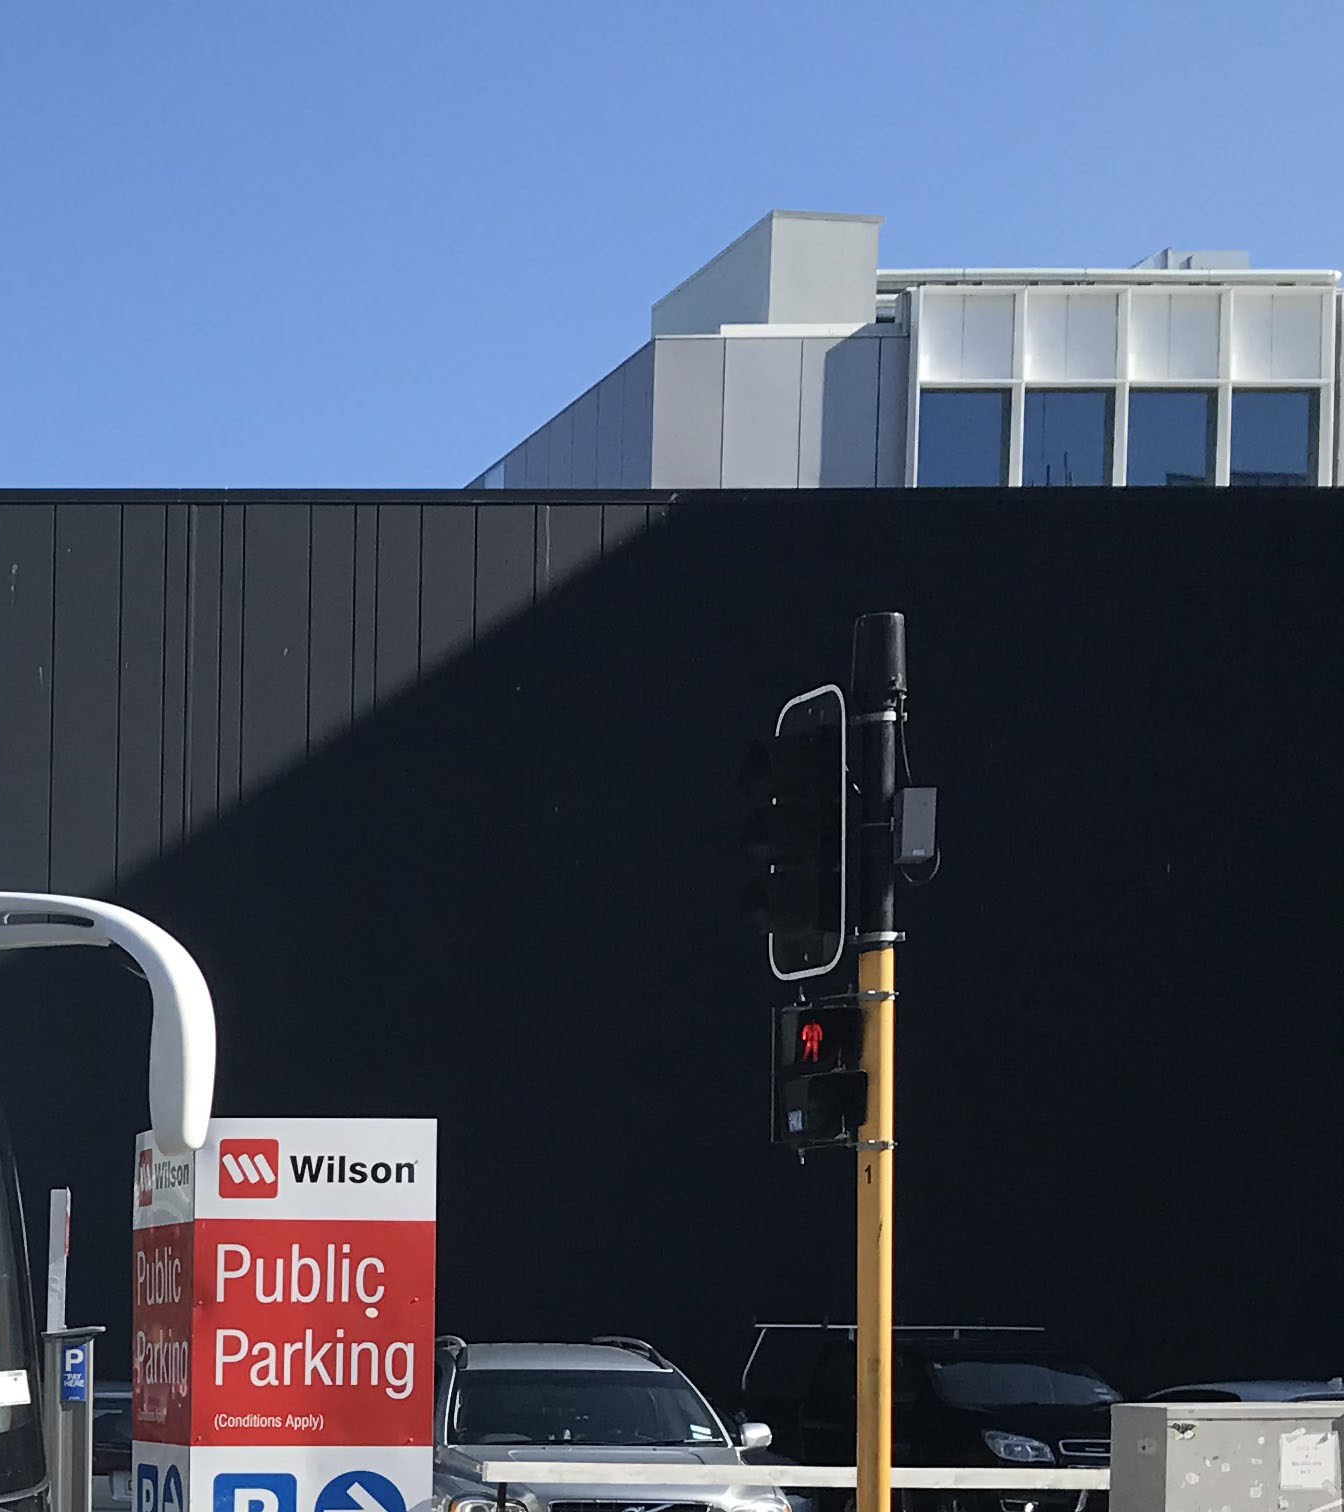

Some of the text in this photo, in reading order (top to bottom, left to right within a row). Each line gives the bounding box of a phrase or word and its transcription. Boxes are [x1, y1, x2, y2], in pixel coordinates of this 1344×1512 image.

[154, 1159, 190, 1190] Wilson
[289, 1155, 415, 1184] Wilson
[864, 1164, 872, 1184] 1
[137, 1247, 181, 1306] Public
[216, 1243, 385, 1304] Public
[66, 1348, 84, 1372] P
[137, 1329, 188, 1397] Parking
[215, 1328, 415, 1400] Parking
[214, 1413, 324, 1430] (Conditions Apply)
